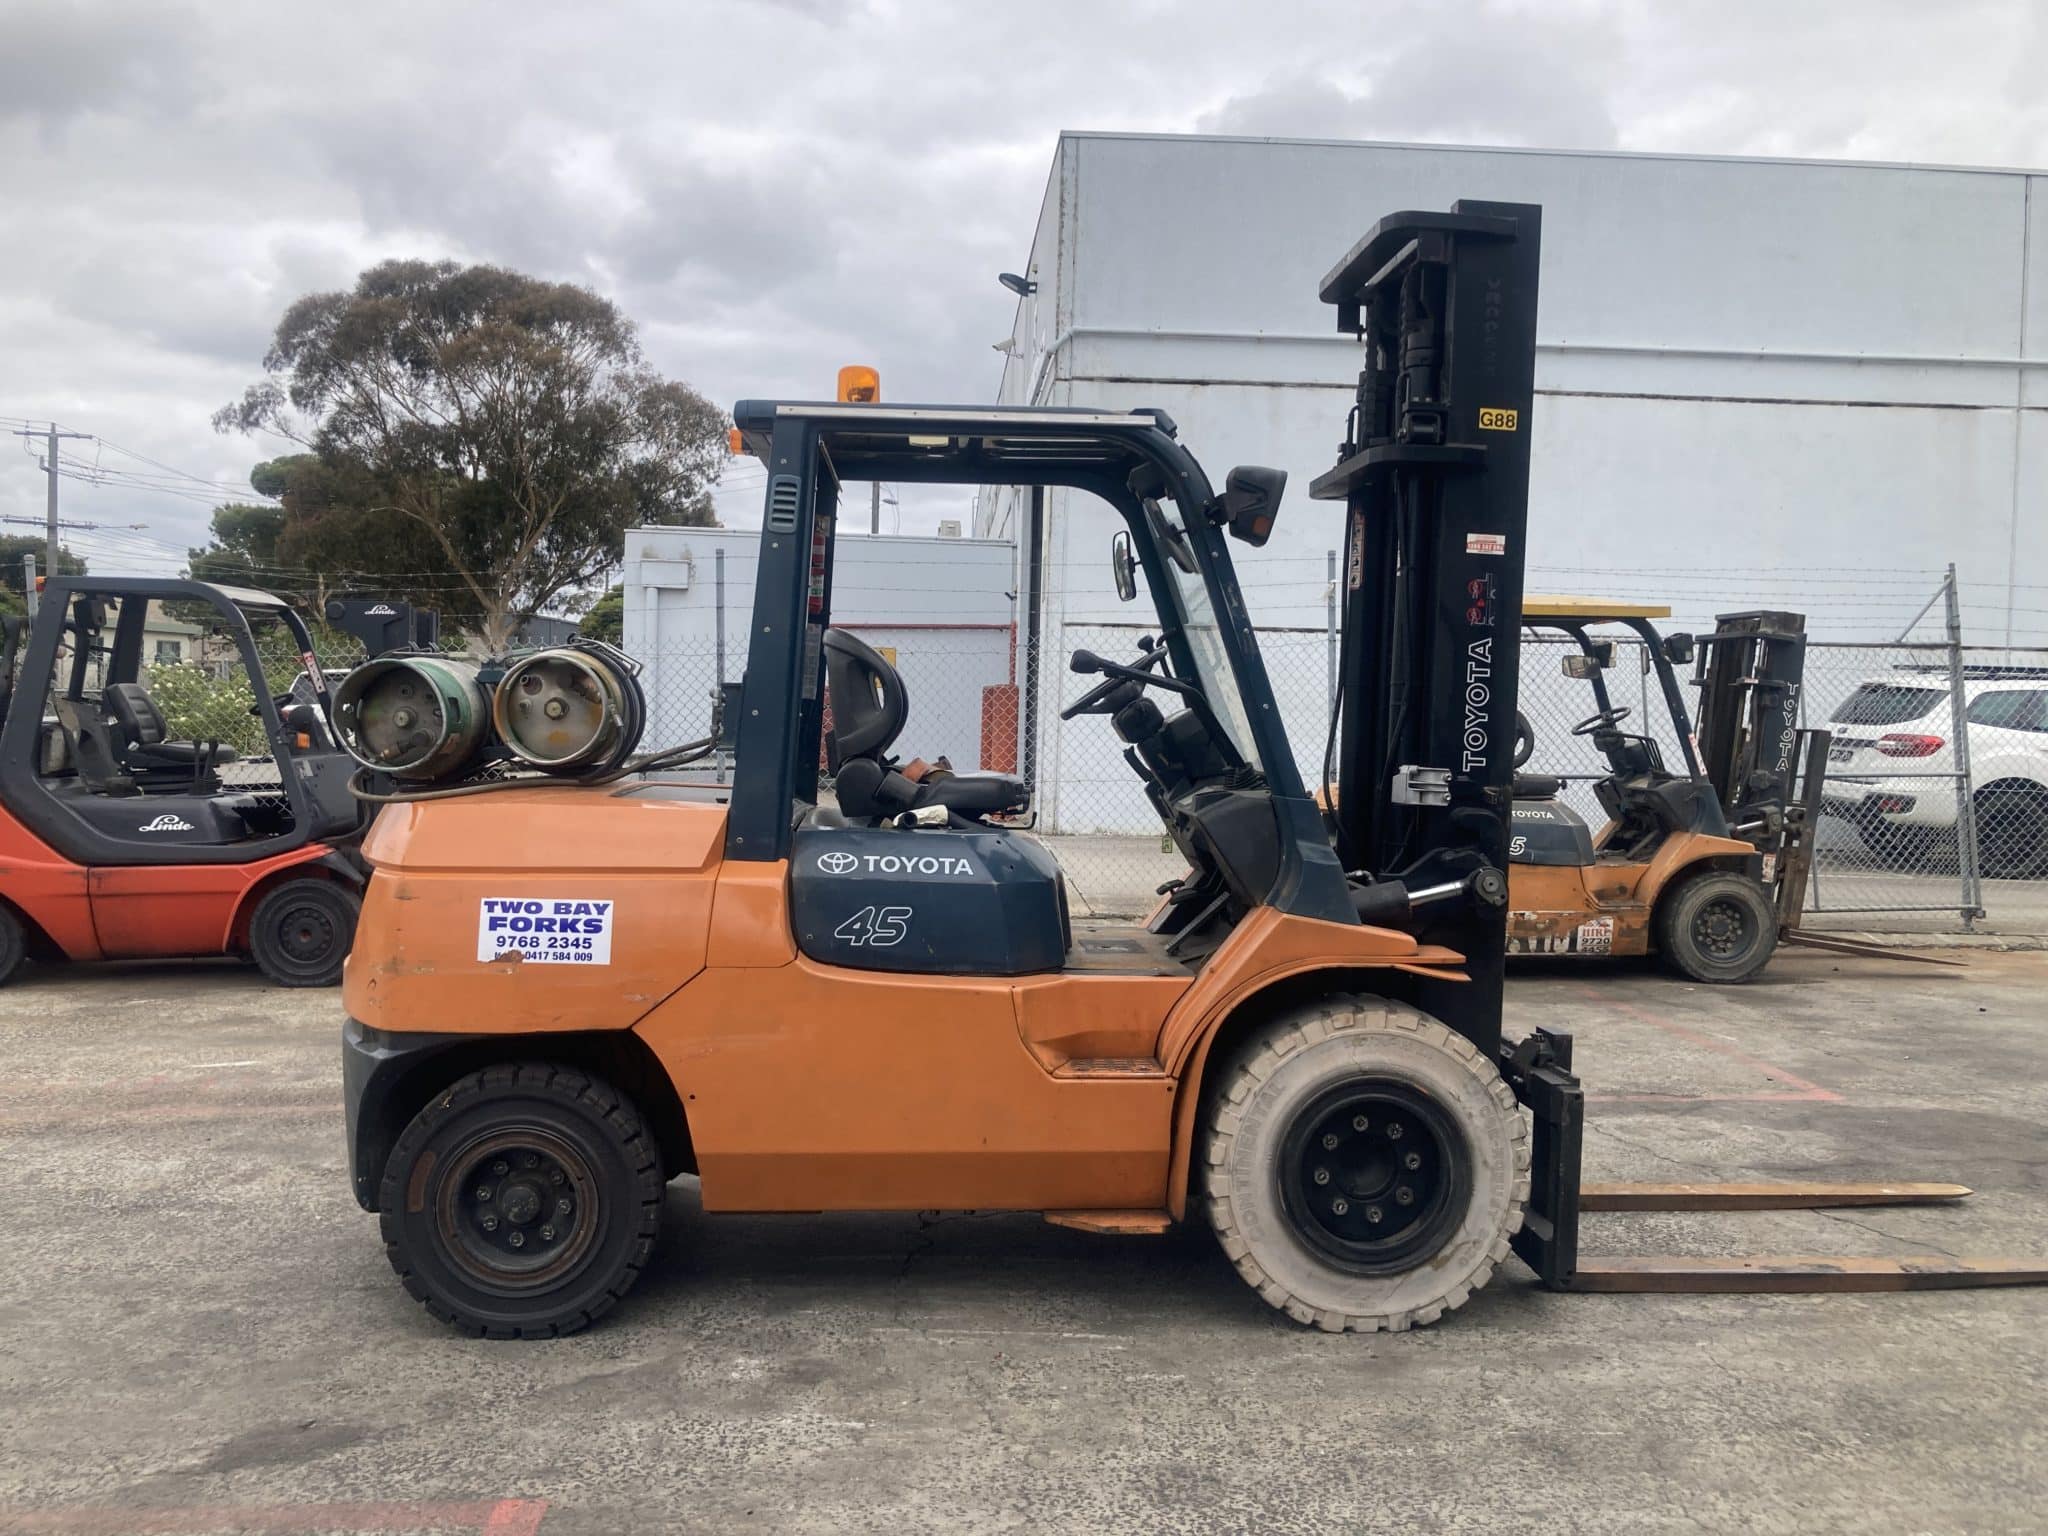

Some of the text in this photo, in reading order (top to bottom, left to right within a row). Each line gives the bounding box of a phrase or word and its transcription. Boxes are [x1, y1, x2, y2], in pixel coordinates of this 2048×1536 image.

[1480, 411, 1515, 428] G88
[363, 604, 399, 615] Linde
[1463, 636, 1494, 773] TOYOTA
[1775, 682, 1798, 772] TOYOTA
[138, 814, 196, 832] Linde
[1509, 836, 1527, 856] 5
[863, 855, 975, 875] TOYOTA
[484, 901, 610, 916] TWO BAY
[489, 916, 603, 934] FORKS
[834, 905, 913, 947] 45
[496, 936, 593, 949] 9768 2345
[1582, 937, 1610, 945] 9720
[525, 951, 593, 962] 0417 584 009
